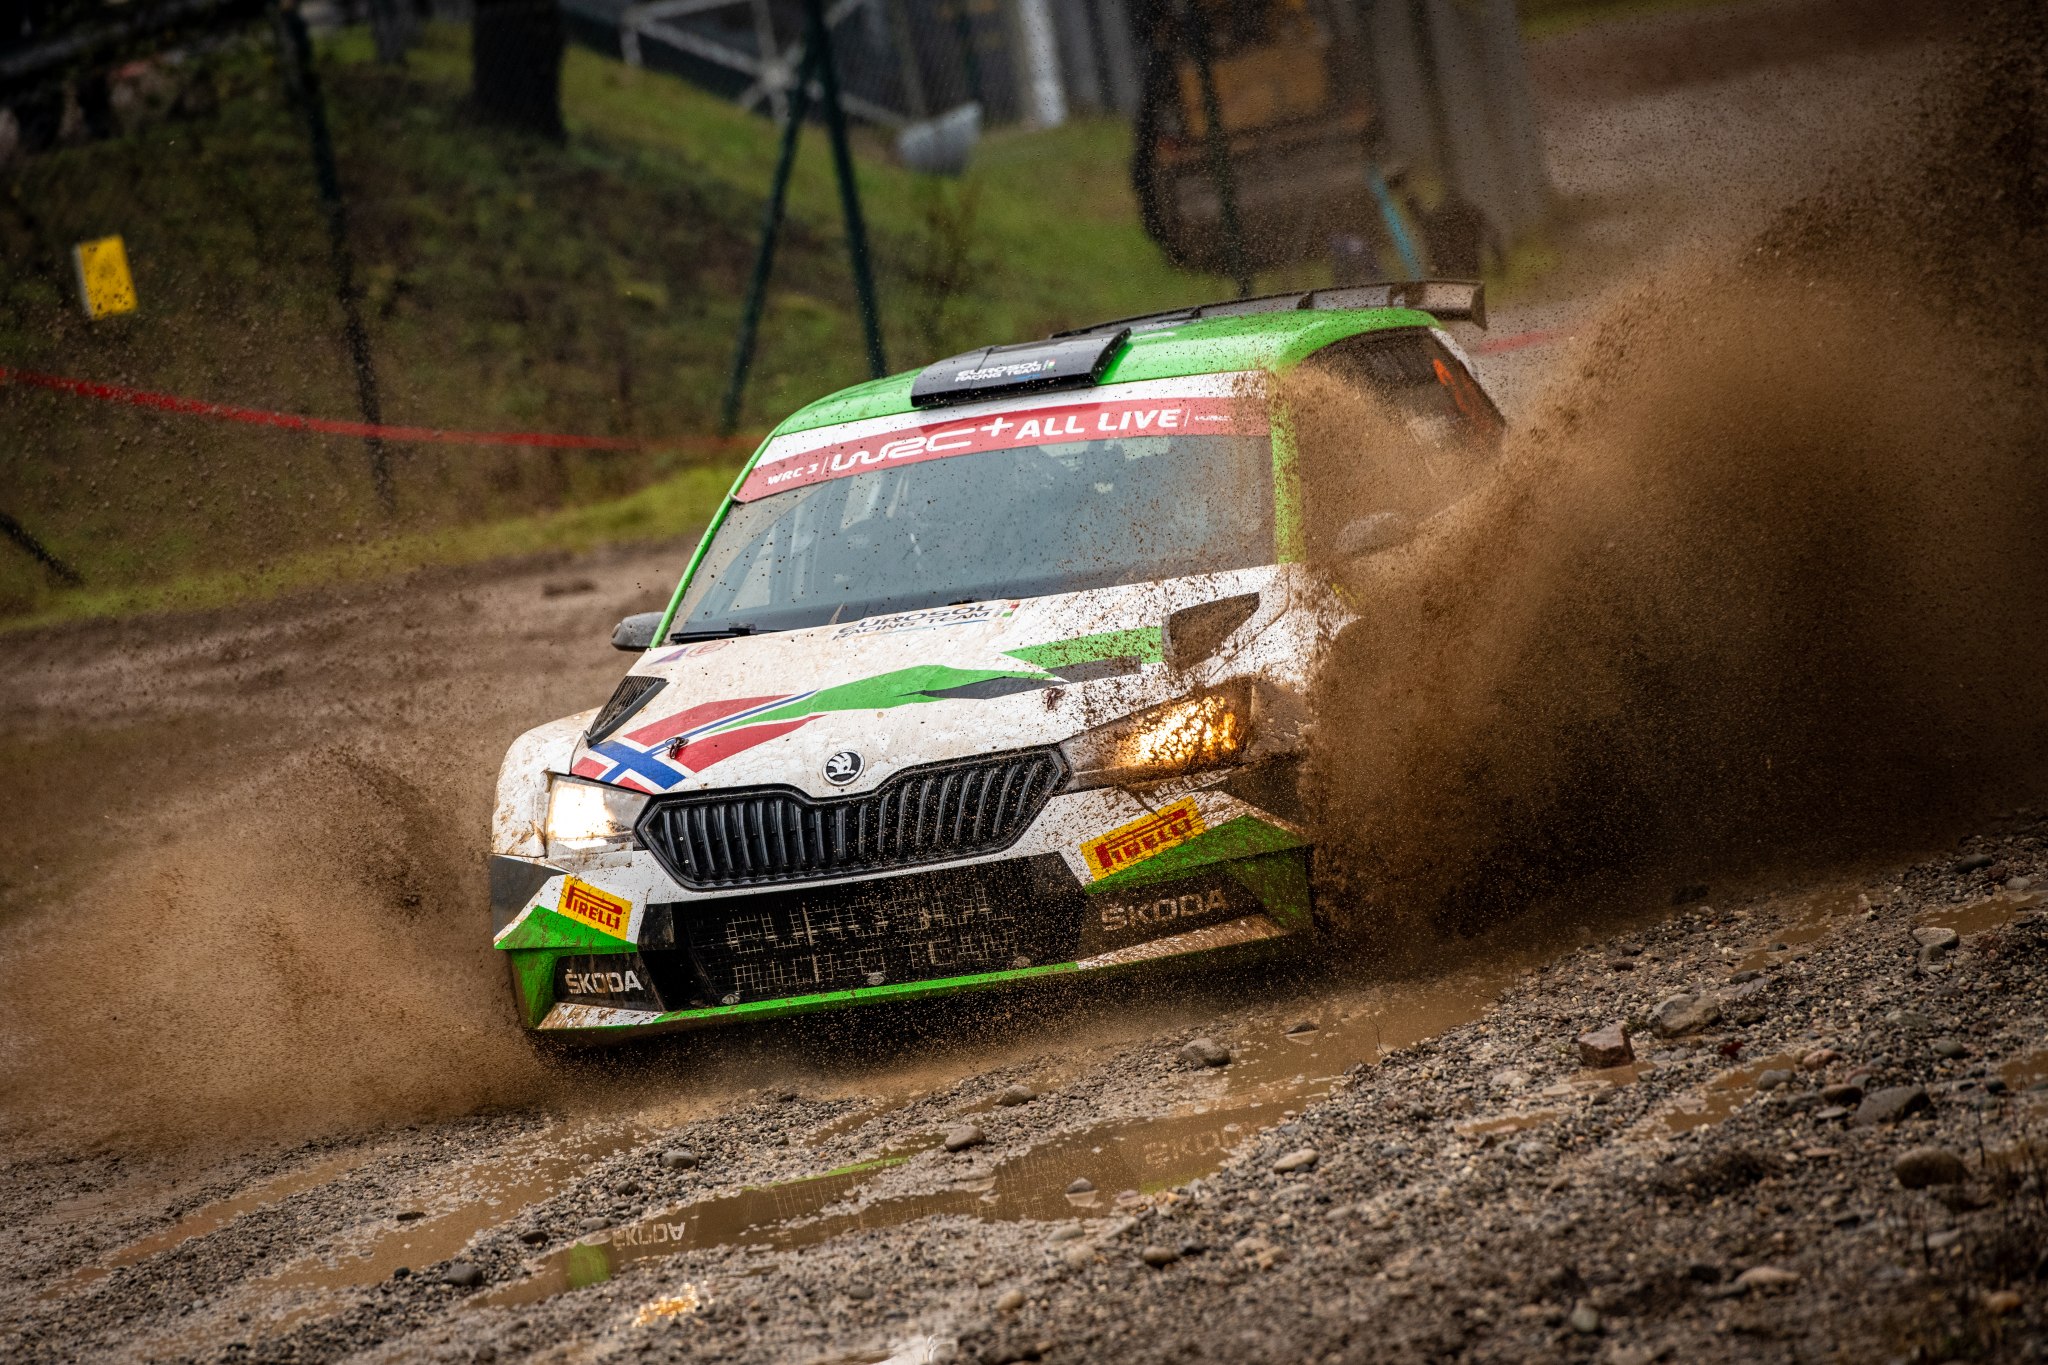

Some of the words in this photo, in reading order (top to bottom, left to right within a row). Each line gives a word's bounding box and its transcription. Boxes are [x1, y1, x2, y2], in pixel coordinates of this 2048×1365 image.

[954, 372, 1002, 383] RACING
[1007, 364, 1041, 377] TEAM
[957, 360, 1043, 378] EUROSOL
[768, 467, 804, 486] WRC
[807, 464, 818, 476] 3
[1015, 415, 1086, 440] ALL
[1097, 408, 1182, 432] LIVE
[831, 621, 916, 641] RACING
[928, 610, 990, 625] TEAM
[838, 604, 994, 635] EUROSOL
[1094, 808, 1193, 869] PIRELLI
[565, 885, 623, 930] PIRELLI
[564, 968, 645, 994] ŠKODA
